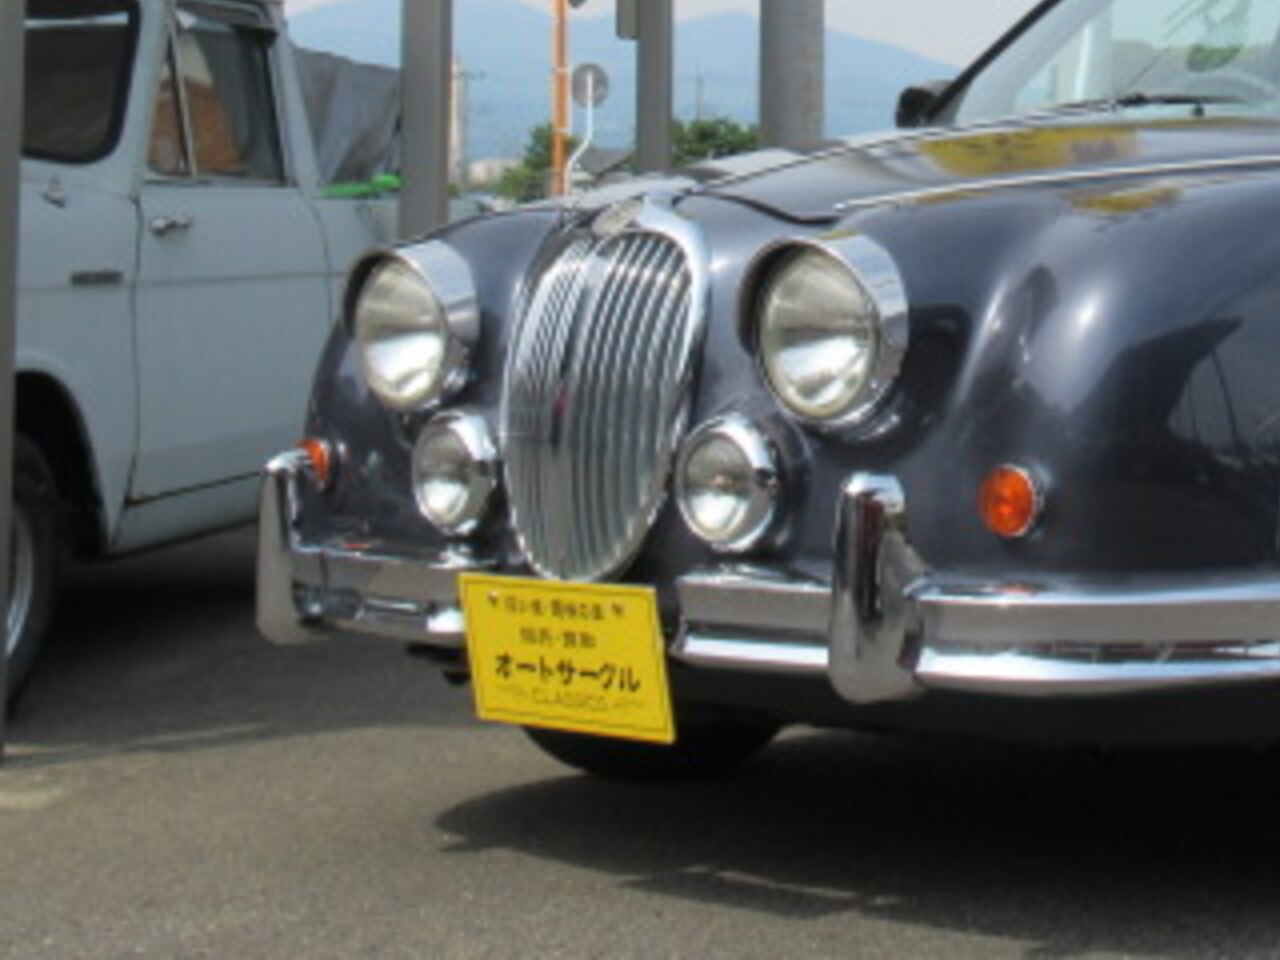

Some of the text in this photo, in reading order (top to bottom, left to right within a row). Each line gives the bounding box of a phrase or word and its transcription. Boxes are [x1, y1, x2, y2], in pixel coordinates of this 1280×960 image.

[496, 651, 640, 692] オートサークル
